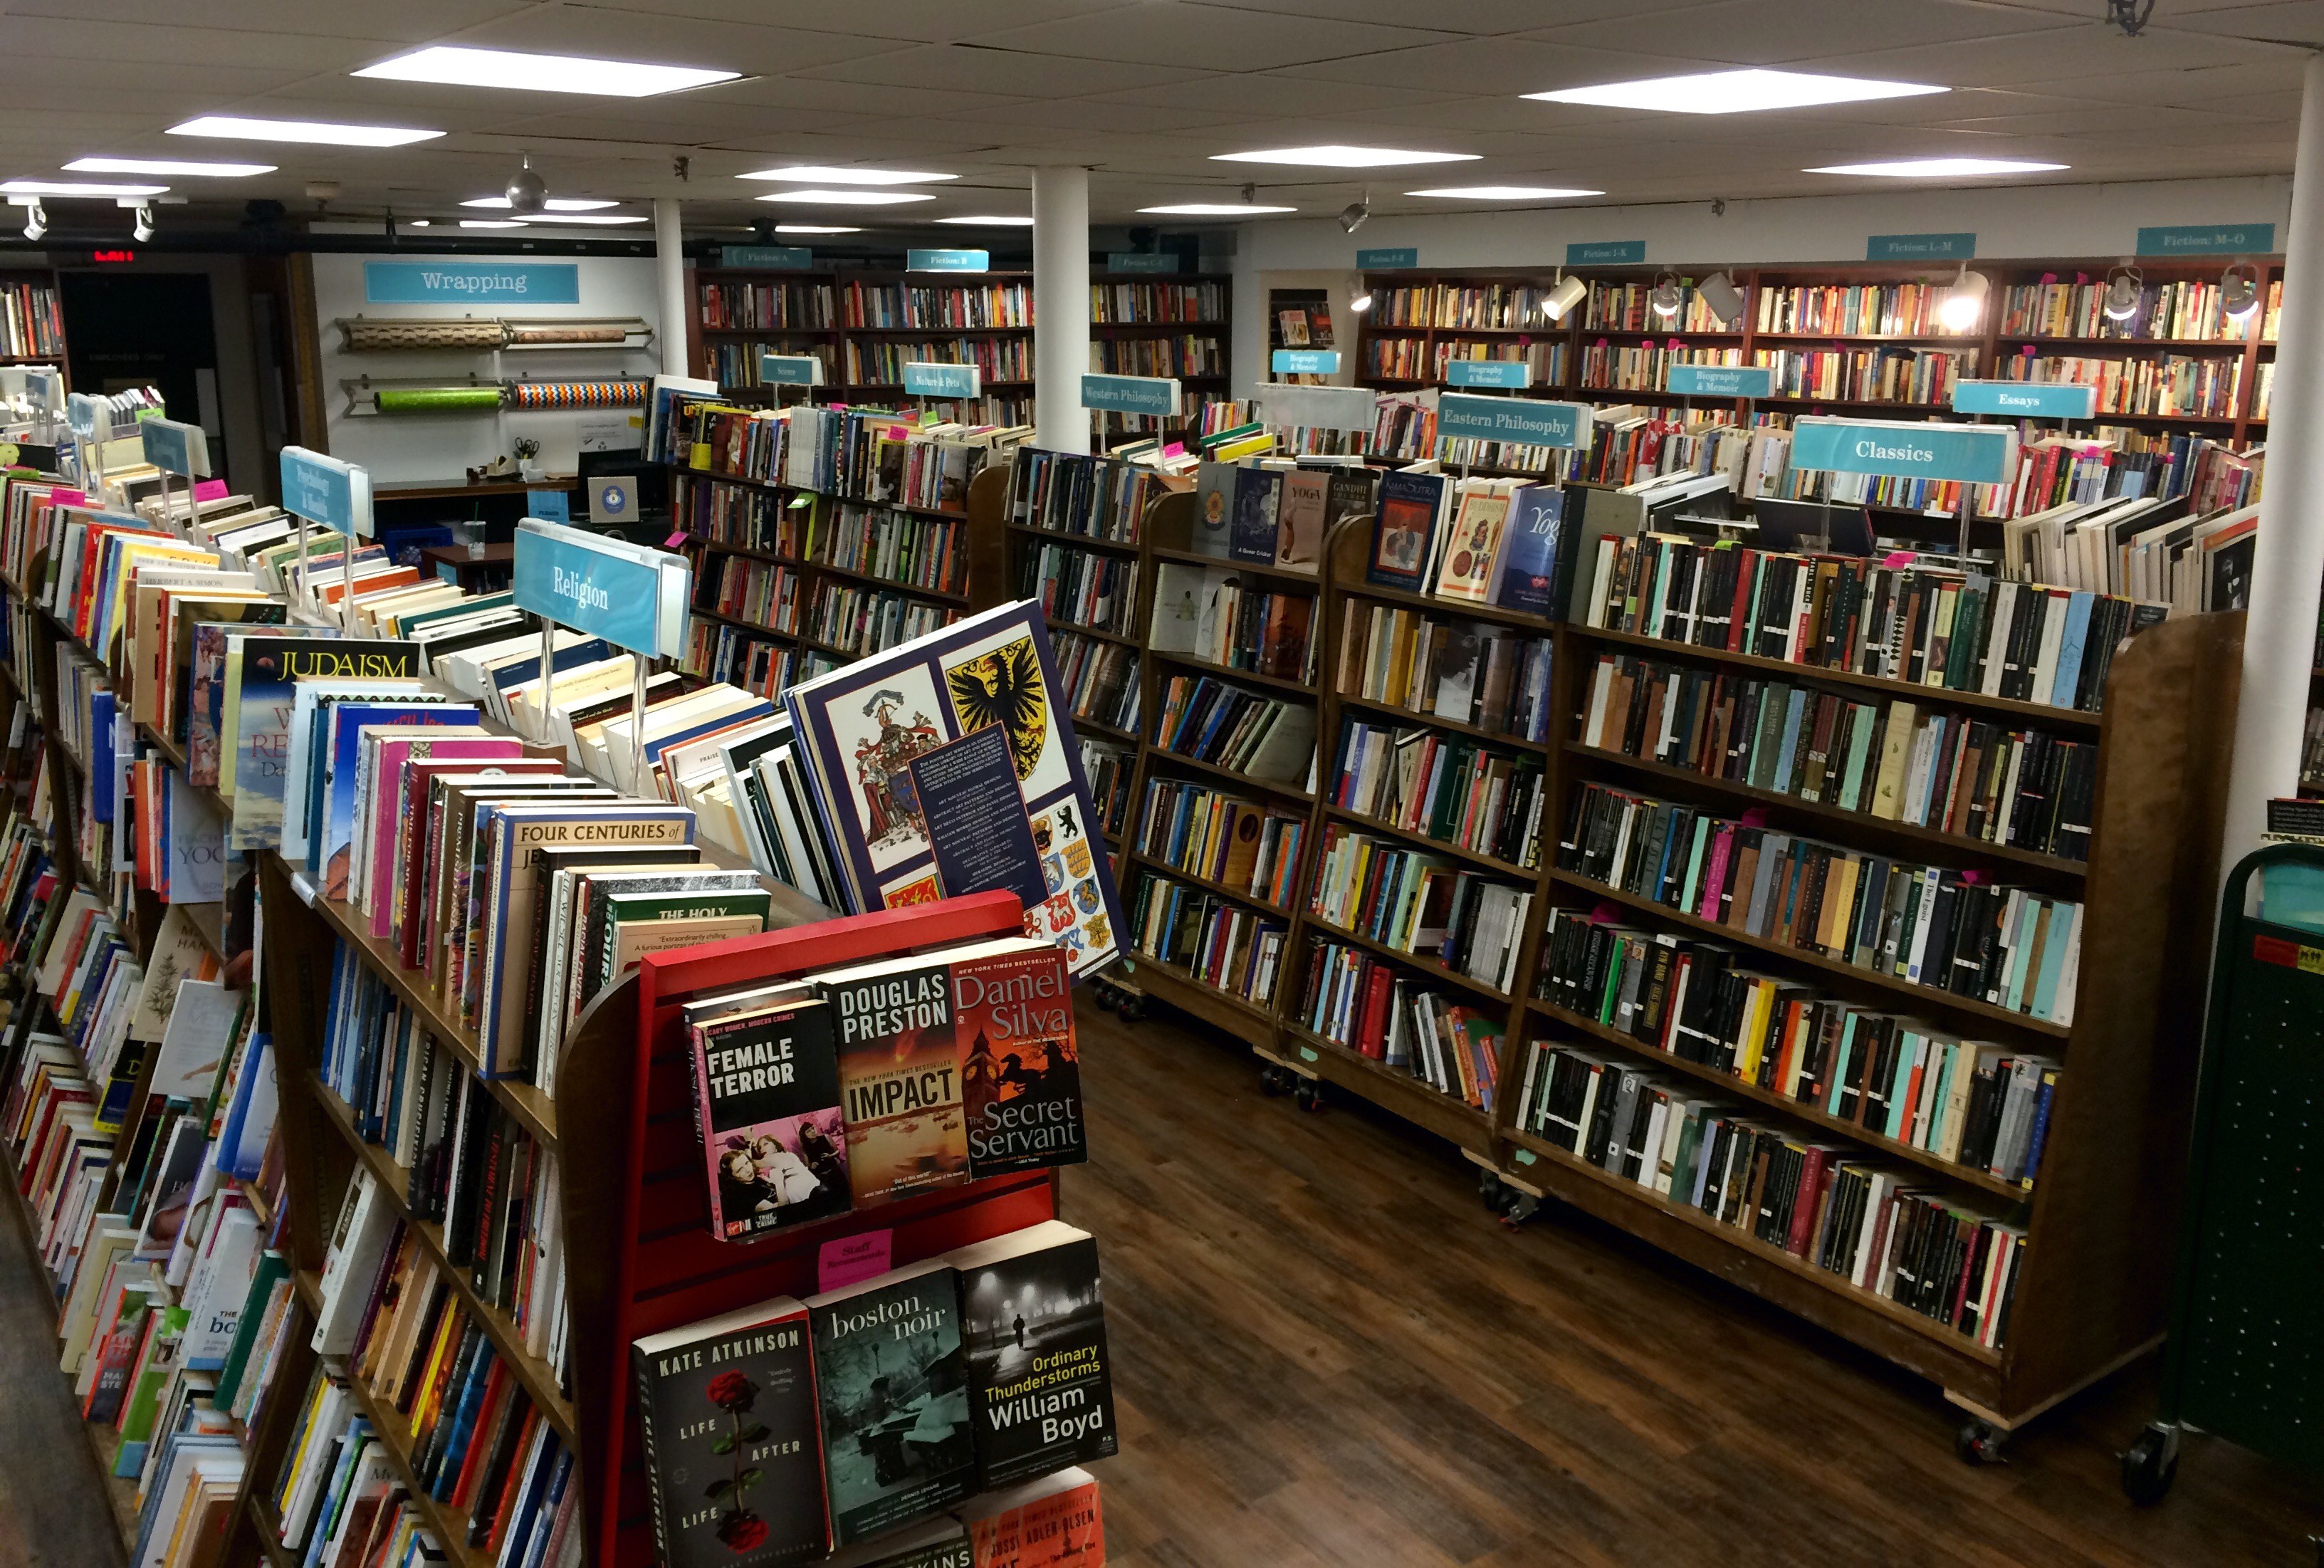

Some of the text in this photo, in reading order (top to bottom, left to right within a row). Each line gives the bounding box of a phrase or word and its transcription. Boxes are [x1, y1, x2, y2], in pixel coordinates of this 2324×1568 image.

[1889, 242, 1927, 253] Fiction:
[2164, 235, 2212, 246] Fiction:
[931, 256, 967, 266] Fiction: B
[1584, 250, 1611, 259] Fiction:
[421, 272, 528, 293] Wrapping
[1289, 355, 1318, 365] Biography
[1467, 366, 1502, 377] Biography
[916, 376, 935, 388] Nature
[946, 378, 960, 388] Pets
[1477, 375, 1502, 383] Memoir
[1696, 372, 1742, 385] Biography
[1706, 383, 1739, 393] Memoir
[1085, 386, 1168, 409] Western Philosophy
[1999, 394, 2040, 407] Essays
[1444, 410, 1569, 437] Eastern Philosophy
[1856, 441, 1933, 462] Classics
[1292, 486, 1321, 500] YOGA
[1333, 482, 1366, 493] GANDHI
[1470, 500, 1506, 512] BUDDHISM
[145, 577, 223, 587] HERBERT SIMON
[553, 566, 609, 610] Religion
[278, 651, 408, 681] JUDAISM
[700, 752, 719, 764] PRAISE
[520, 824, 680, 842] FOUR CENTURIES of
[659, 907, 728, 919] THE HOLY
[1921, 884, 1935, 921] The Egoist
[558, 899, 569, 952] WIESEL
[575, 914, 588, 1000] RACIAL FEVER
[1015, 957, 1056, 968] BESTSELLER
[1654, 949, 1669, 981] AYN RAND
[840, 973, 946, 1017] DOUGLAS
[954, 963, 1064, 1010] Daniel
[748, 1018, 773, 1028] MODERN
[773, 1013, 795, 1023] CRIMES
[843, 1000, 948, 1044] PRESTON
[991, 1003, 1068, 1040] Silva
[694, 1029, 703, 1068] FEMALE
[708, 1037, 794, 1075] FEMALE
[710, 1062, 795, 1099] TERROR
[849, 1060, 952, 1086] THE NEW YORK TIMES BESTSELLER
[697, 1070, 707, 1105] TERROR
[849, 1067, 953, 1122] IMPACT
[967, 1096, 1077, 1131] The Secret
[969, 1121, 1080, 1159] Servant
[757, 1218, 778, 1228] CRIME
[758, 1212, 773, 1221] TRUE
[826, 1249, 885, 1270] Recommends
[842, 1240, 872, 1257] Staff
[830, 1296, 921, 1339] boston
[894, 1306, 946, 1341] noir
[659, 1329, 799, 1377] KATE ATKINSON
[1032, 1345, 1097, 1372] Ordinary
[985, 1361, 1101, 1403] Thunderstorms
[988, 1388, 1085, 1431] William
[680, 1418, 716, 1440] LIFE
[1042, 1404, 1104, 1444] Boyd
[644, 1415, 656, 1458] KATE
[752, 1440, 800, 1461] AFTER
[649, 1463, 665, 1550] ATKINSON
[681, 1506, 718, 1529] LIFE
[990, 1534, 1020, 1559] JUSSI
[1027, 1508, 1094, 1546] ADLER-OLSEN
[906, 1550, 970, 1568] KINS
